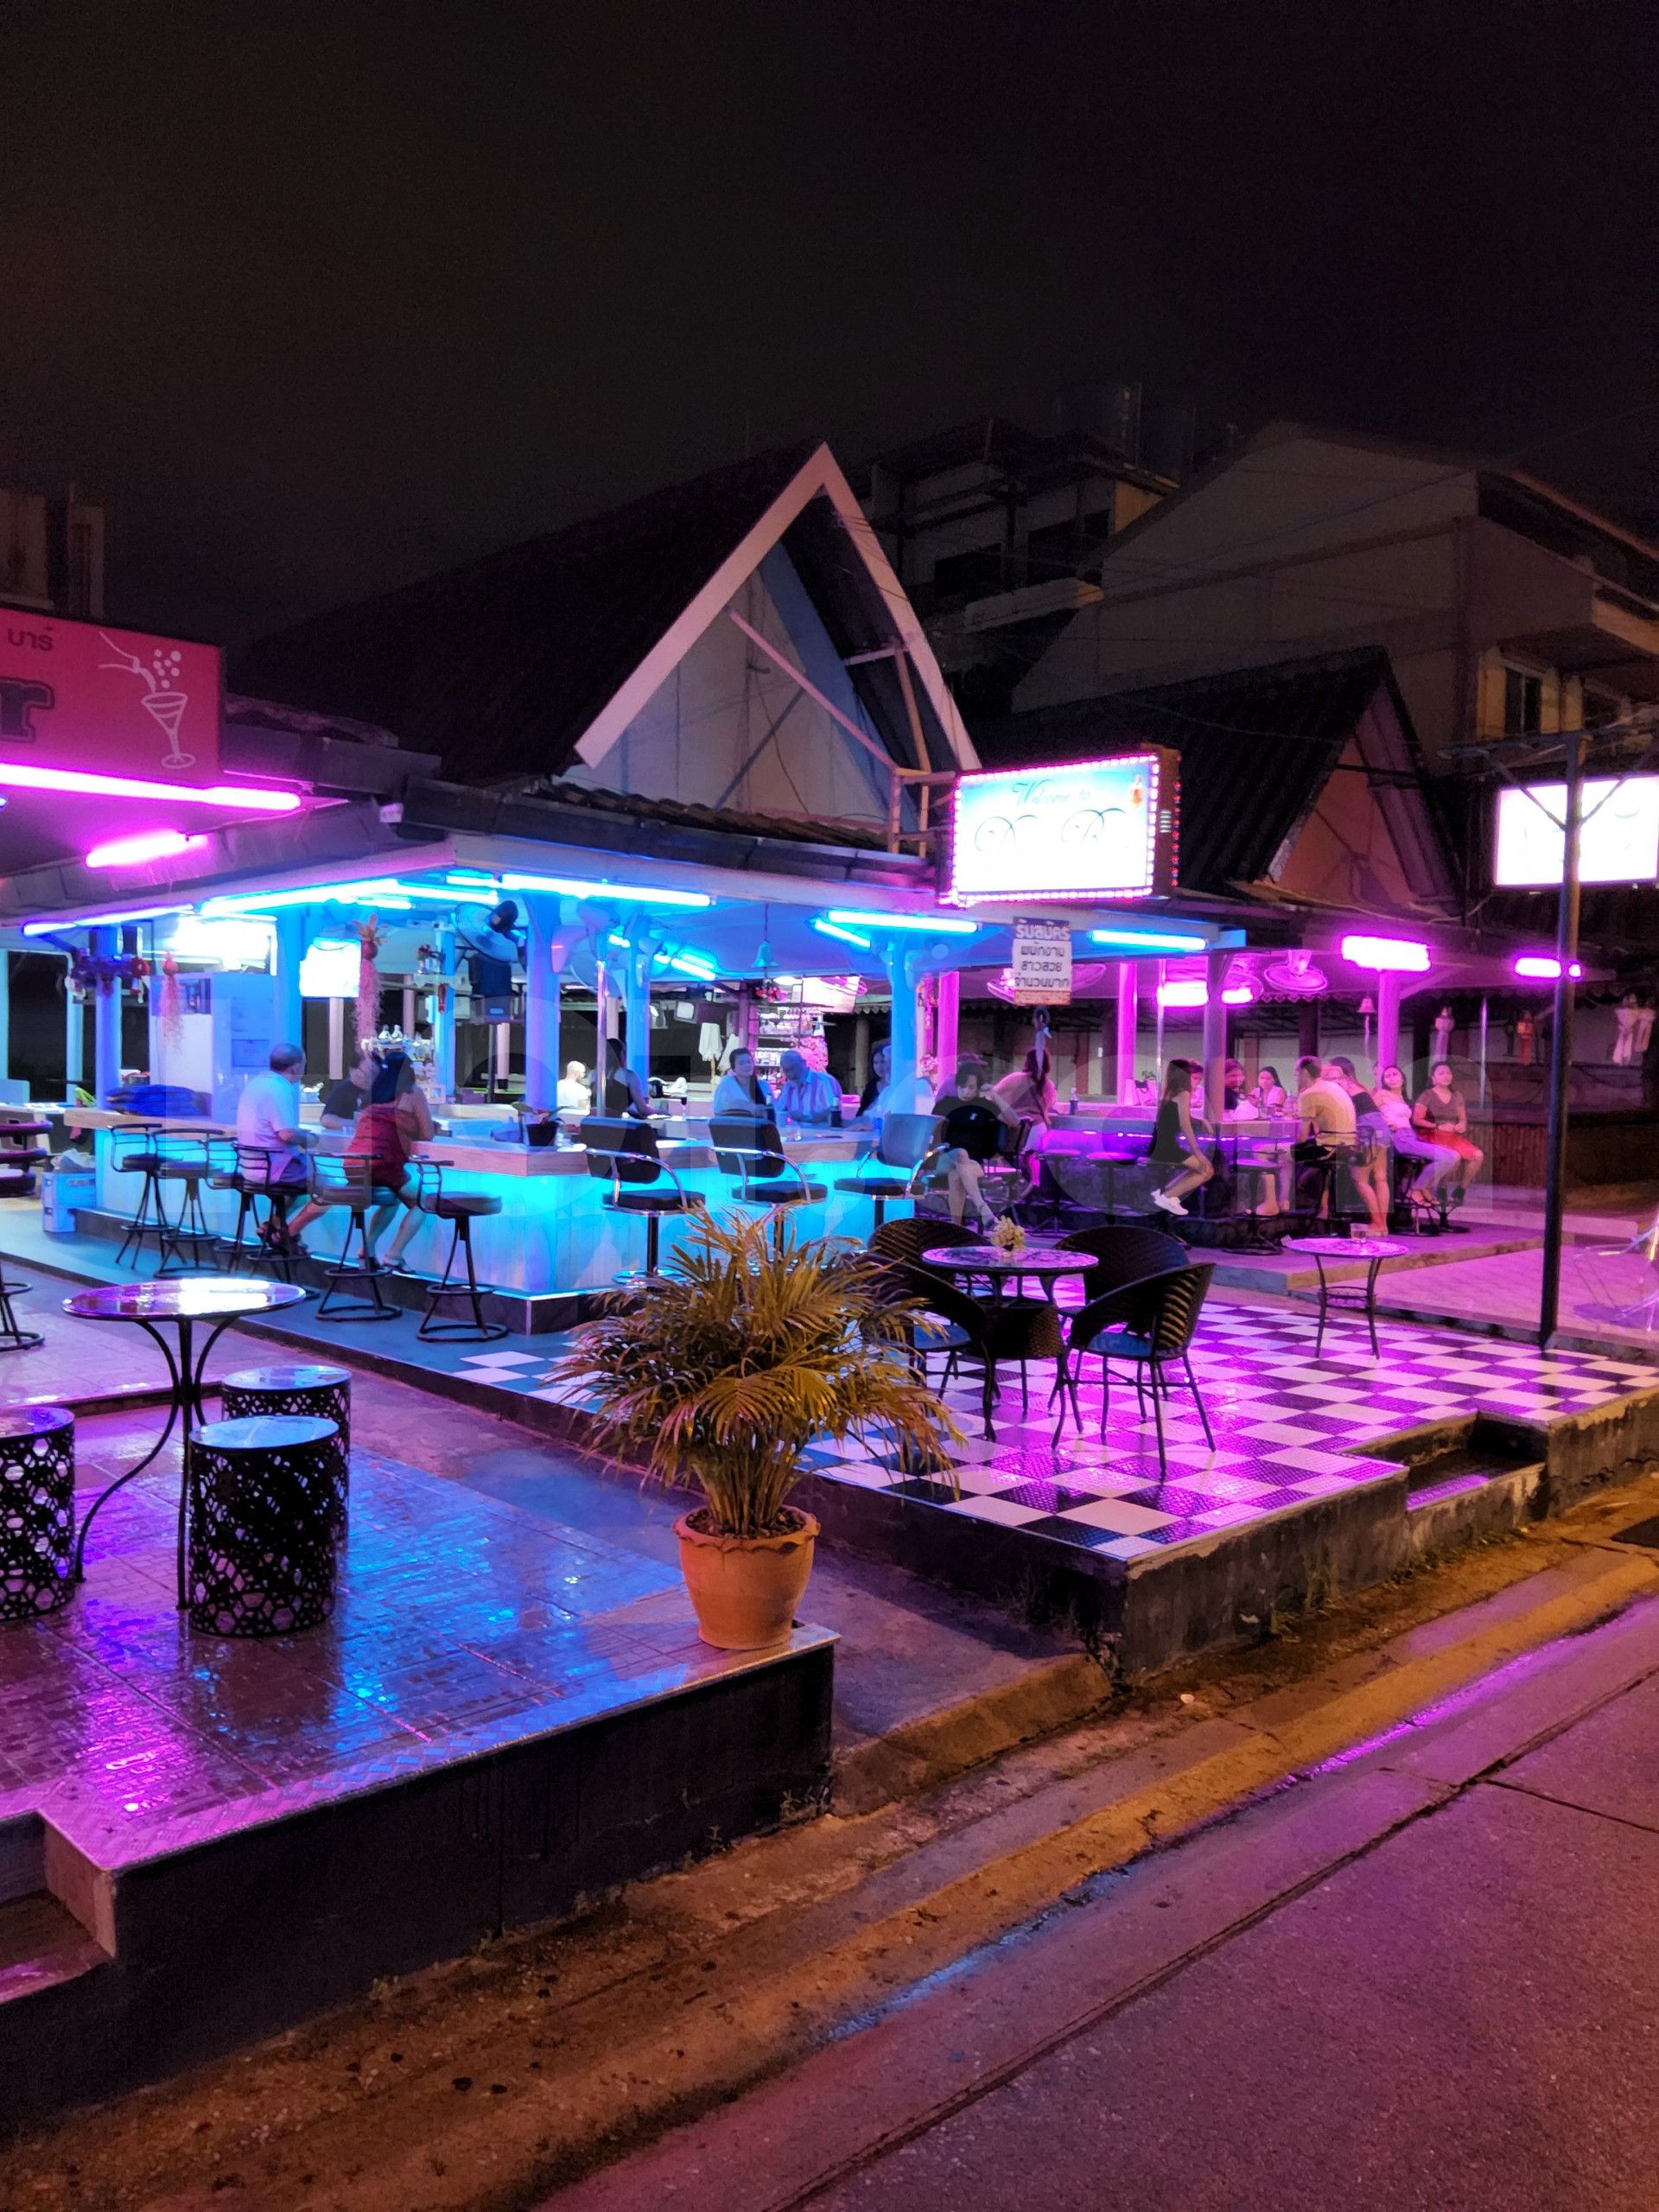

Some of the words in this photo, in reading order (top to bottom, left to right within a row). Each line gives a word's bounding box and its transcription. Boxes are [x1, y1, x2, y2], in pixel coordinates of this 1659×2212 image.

[8, 626, 54, 652] บาร์
[1015, 918, 1071, 942] รับสมัคร
[1020, 941, 1065, 957] พนักงาน
